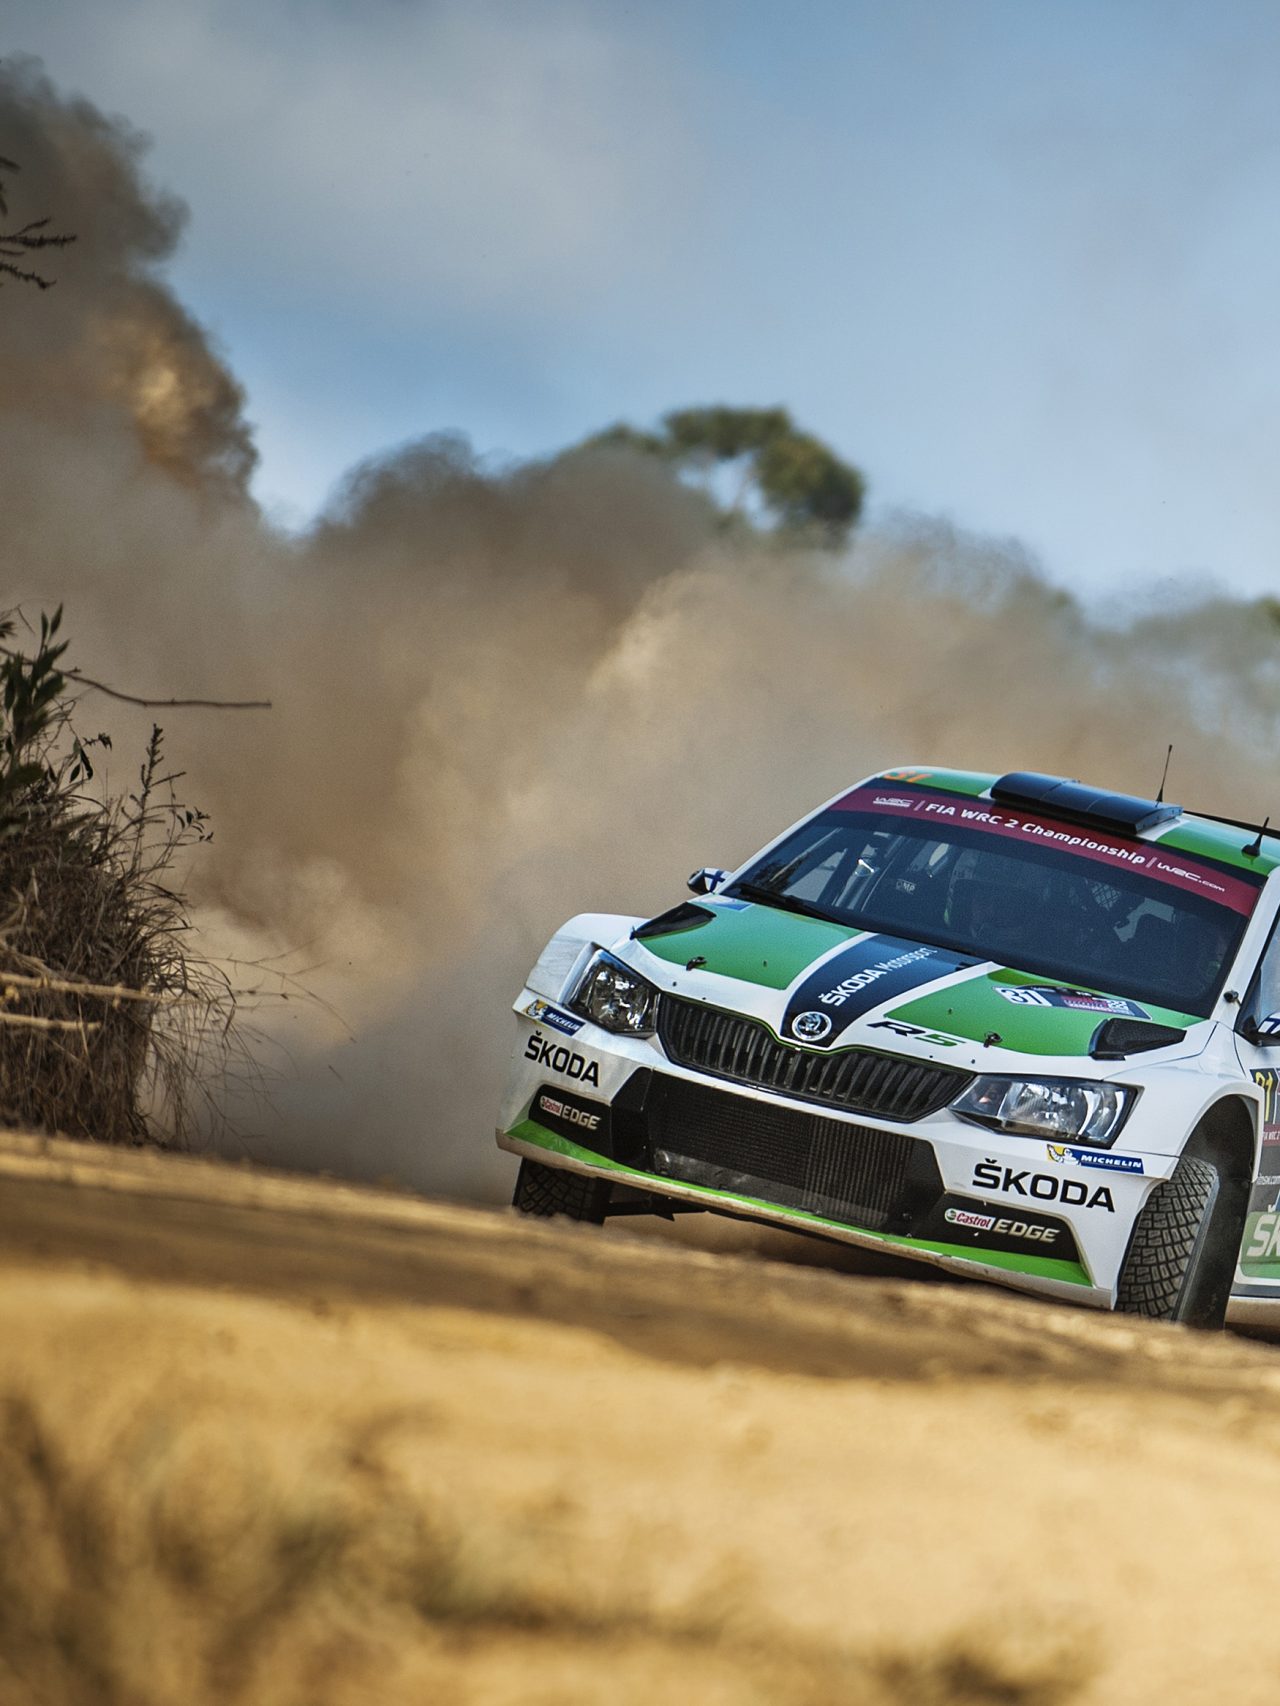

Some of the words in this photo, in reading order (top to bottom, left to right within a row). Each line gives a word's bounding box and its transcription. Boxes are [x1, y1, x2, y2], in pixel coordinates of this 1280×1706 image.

[925, 803, 956, 816] FIA
[961, 809, 1003, 825] WRC
[1004, 818, 1019, 829] 2
[1022, 823, 1146, 865] Championship
[818, 968, 887, 1006] ŠKODA
[874, 947, 938, 972] Motorsport
[1000, 989, 1043, 1005] 31
[547, 1012, 581, 1030] MICHELIN
[866, 1020, 966, 1047] R5
[524, 1030, 599, 1088] ŠKODA
[562, 1105, 601, 1130] EDGE
[1081, 1155, 1142, 1168] MICHELIN
[972, 1158, 1115, 1213] ŠKODA
[955, 1212, 992, 1229] Castrol
[994, 1219, 1060, 1243] EDGE
